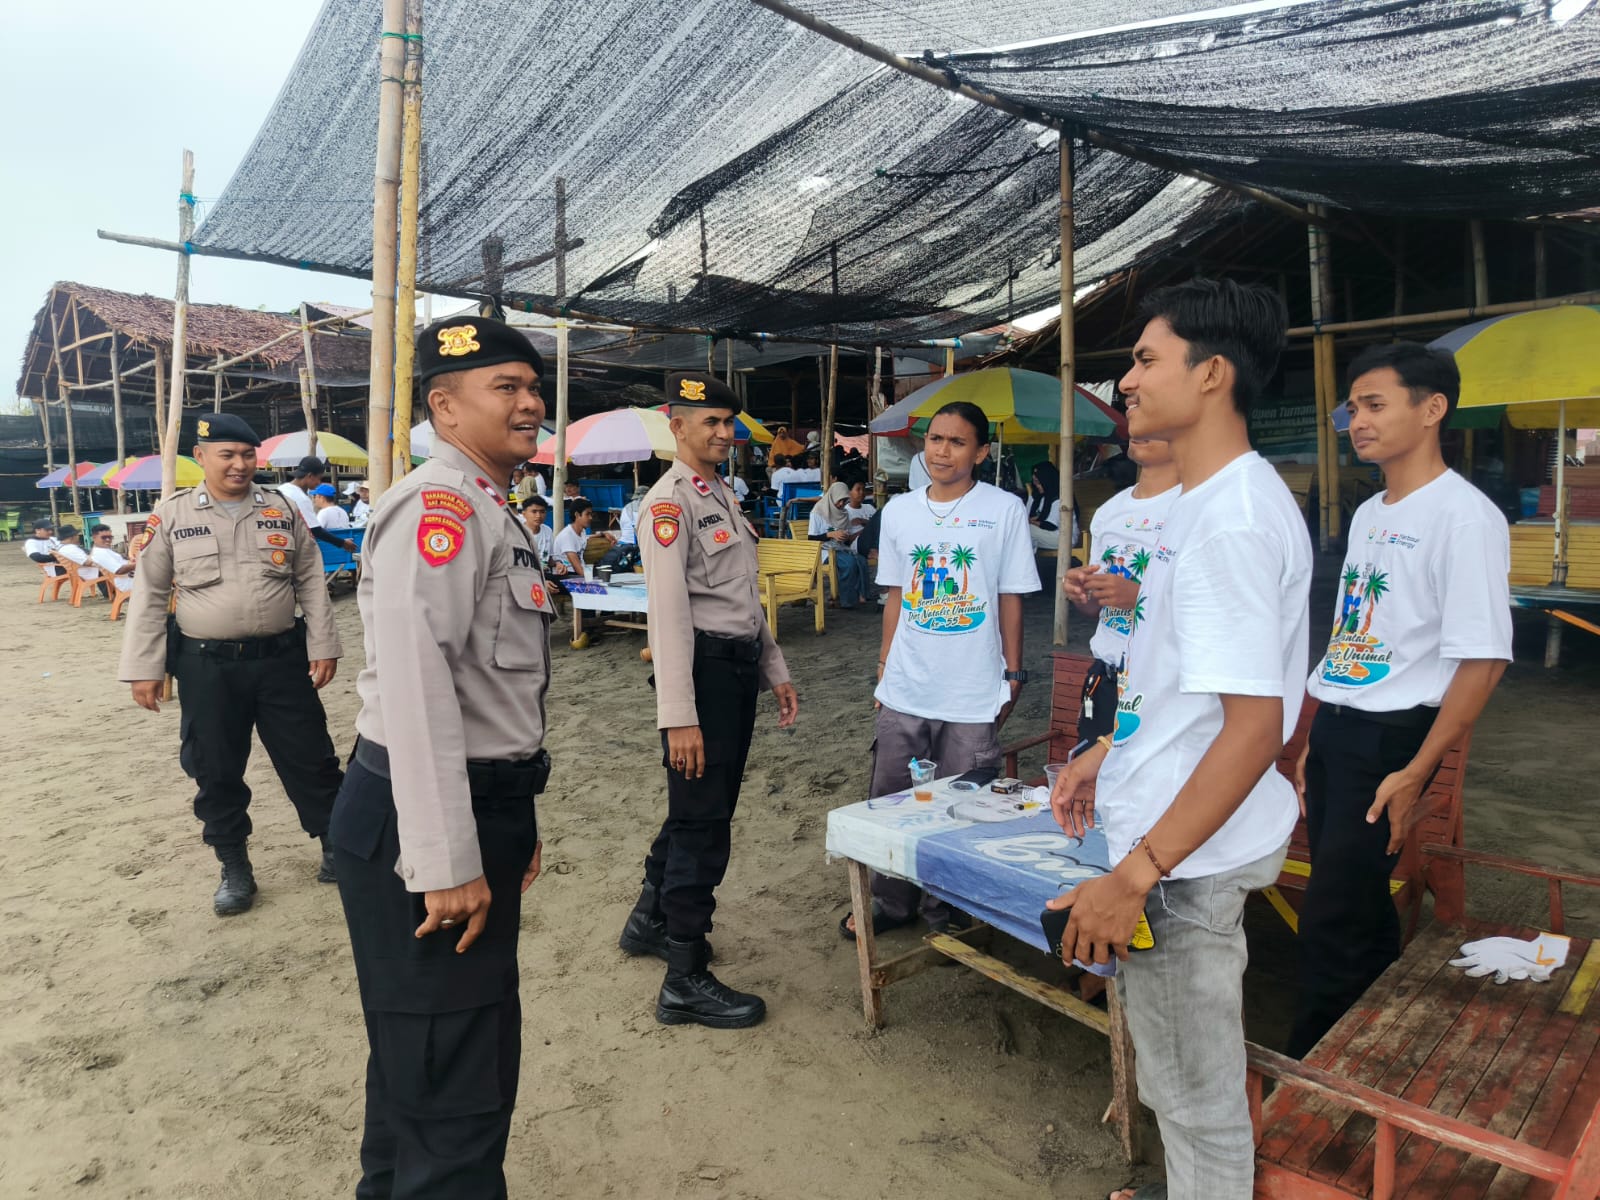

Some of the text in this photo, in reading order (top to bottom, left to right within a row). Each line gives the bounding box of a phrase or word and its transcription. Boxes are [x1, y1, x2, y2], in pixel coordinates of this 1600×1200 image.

[173, 525, 212, 540] YUDHA
[921, 607, 950, 620] Natalis
[952, 601, 988, 616] Unimal
[1343, 647, 1393, 663] Unimal
